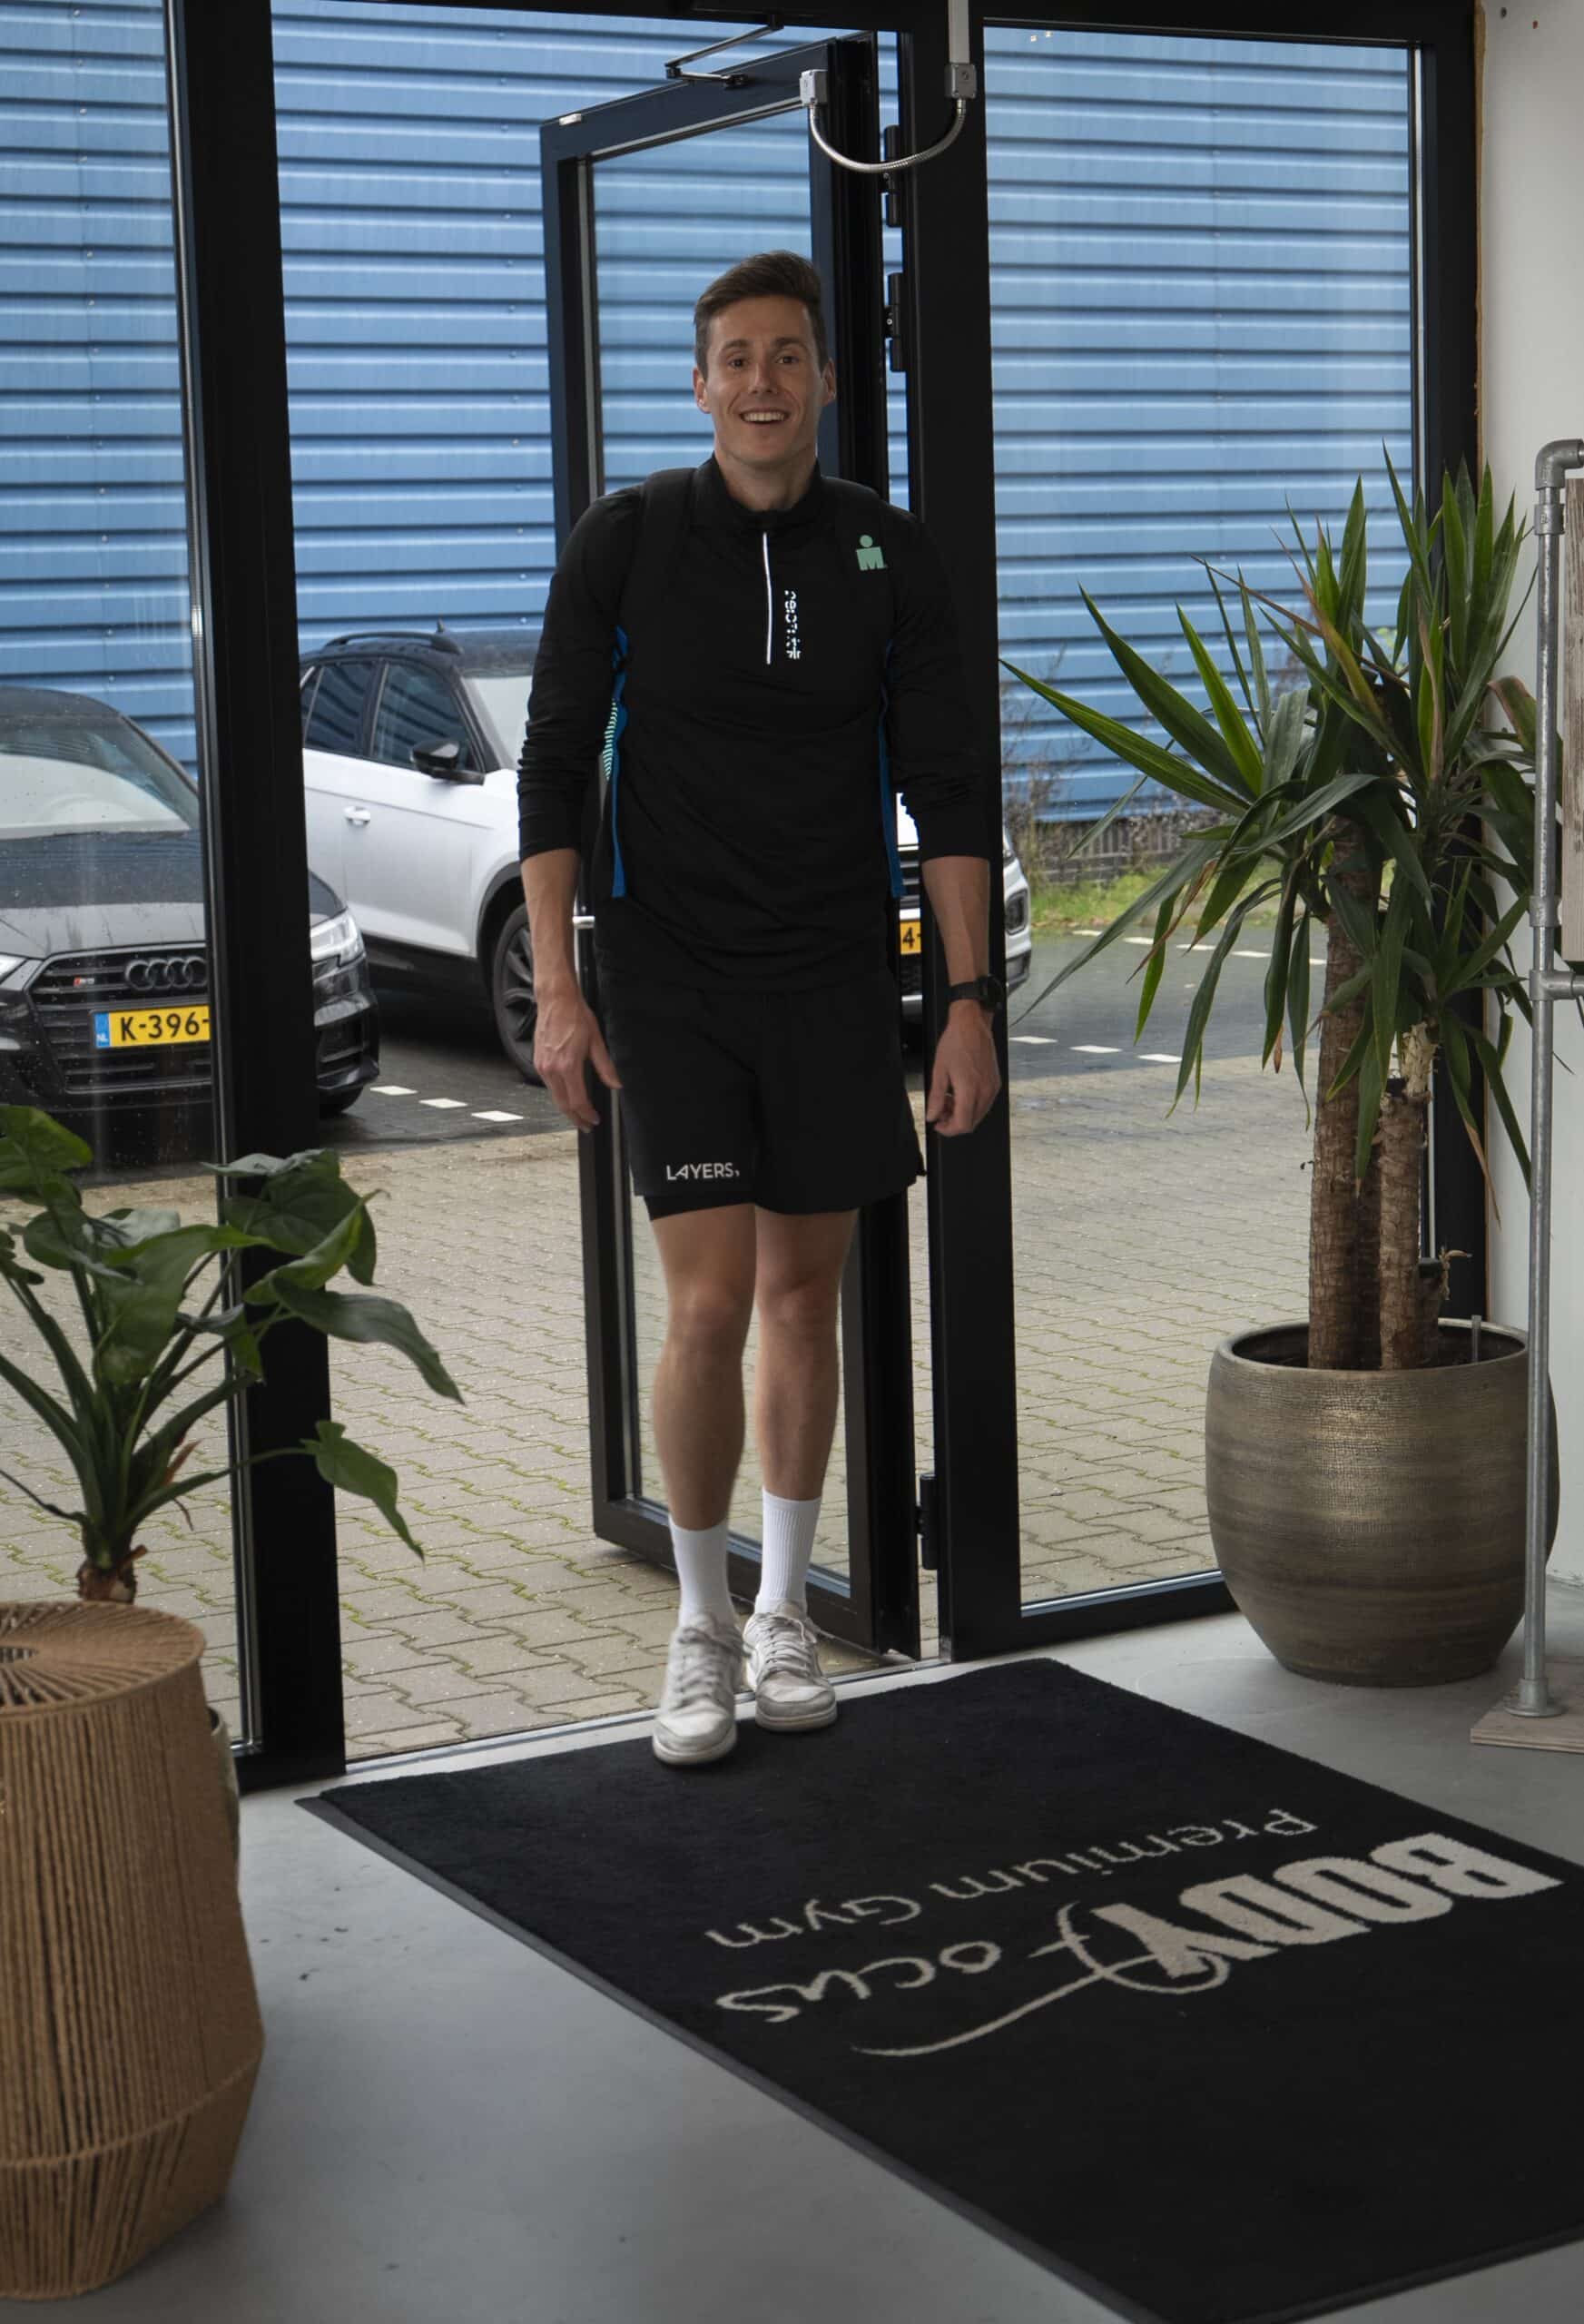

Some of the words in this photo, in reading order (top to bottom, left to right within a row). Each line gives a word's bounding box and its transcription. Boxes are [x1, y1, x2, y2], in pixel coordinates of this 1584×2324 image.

[930, 1808, 1317, 1899] Premium
[705, 1896, 921, 1948] Gym
[1091, 1832, 1563, 1979] BODY
